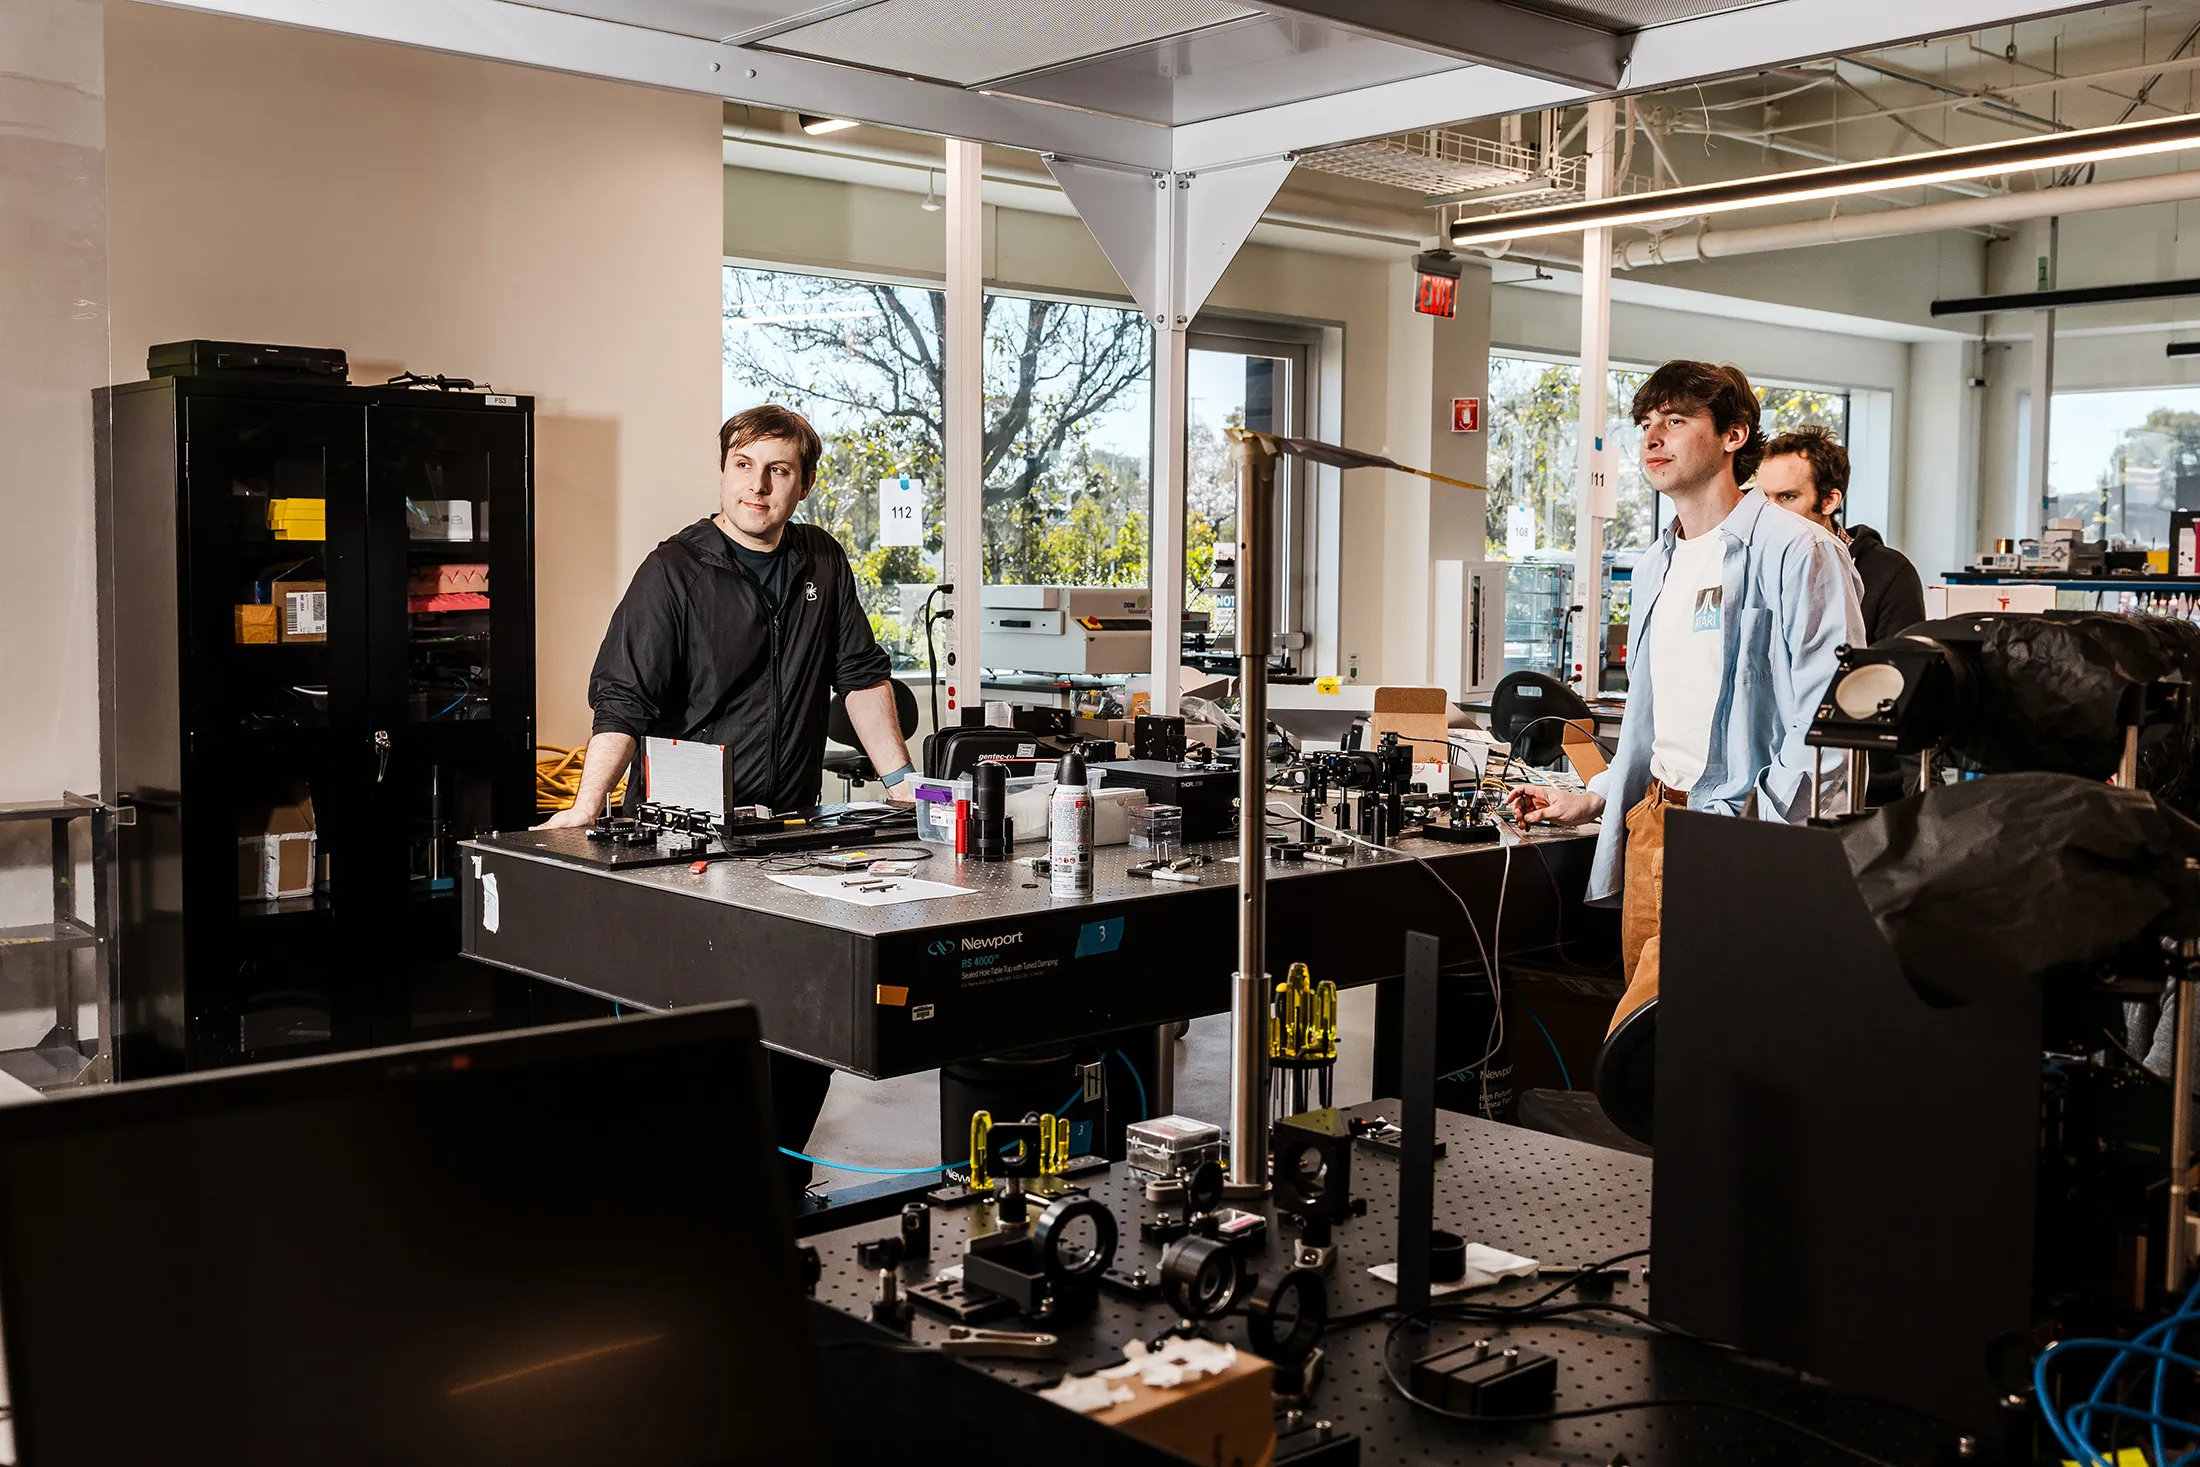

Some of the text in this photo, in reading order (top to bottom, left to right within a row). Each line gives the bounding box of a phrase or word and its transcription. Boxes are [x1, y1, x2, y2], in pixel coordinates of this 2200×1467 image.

[1420, 276, 1453, 316] EXIT
[892, 506, 912, 519] 112
[1515, 527, 1529, 537] 108
[1695, 613, 1717, 627] ATARI
[961, 931, 1024, 951] Newport
[1098, 925, 1107, 942] 3
[961, 958, 972, 969] RS
[961, 970, 979, 980] Sealed
[979, 968, 990, 977] Hole
[990, 965, 1004, 975] Table
[1003, 964, 1013, 973] Top
[1012, 963, 1024, 971] with
[1037, 958, 1059, 968] Damping
